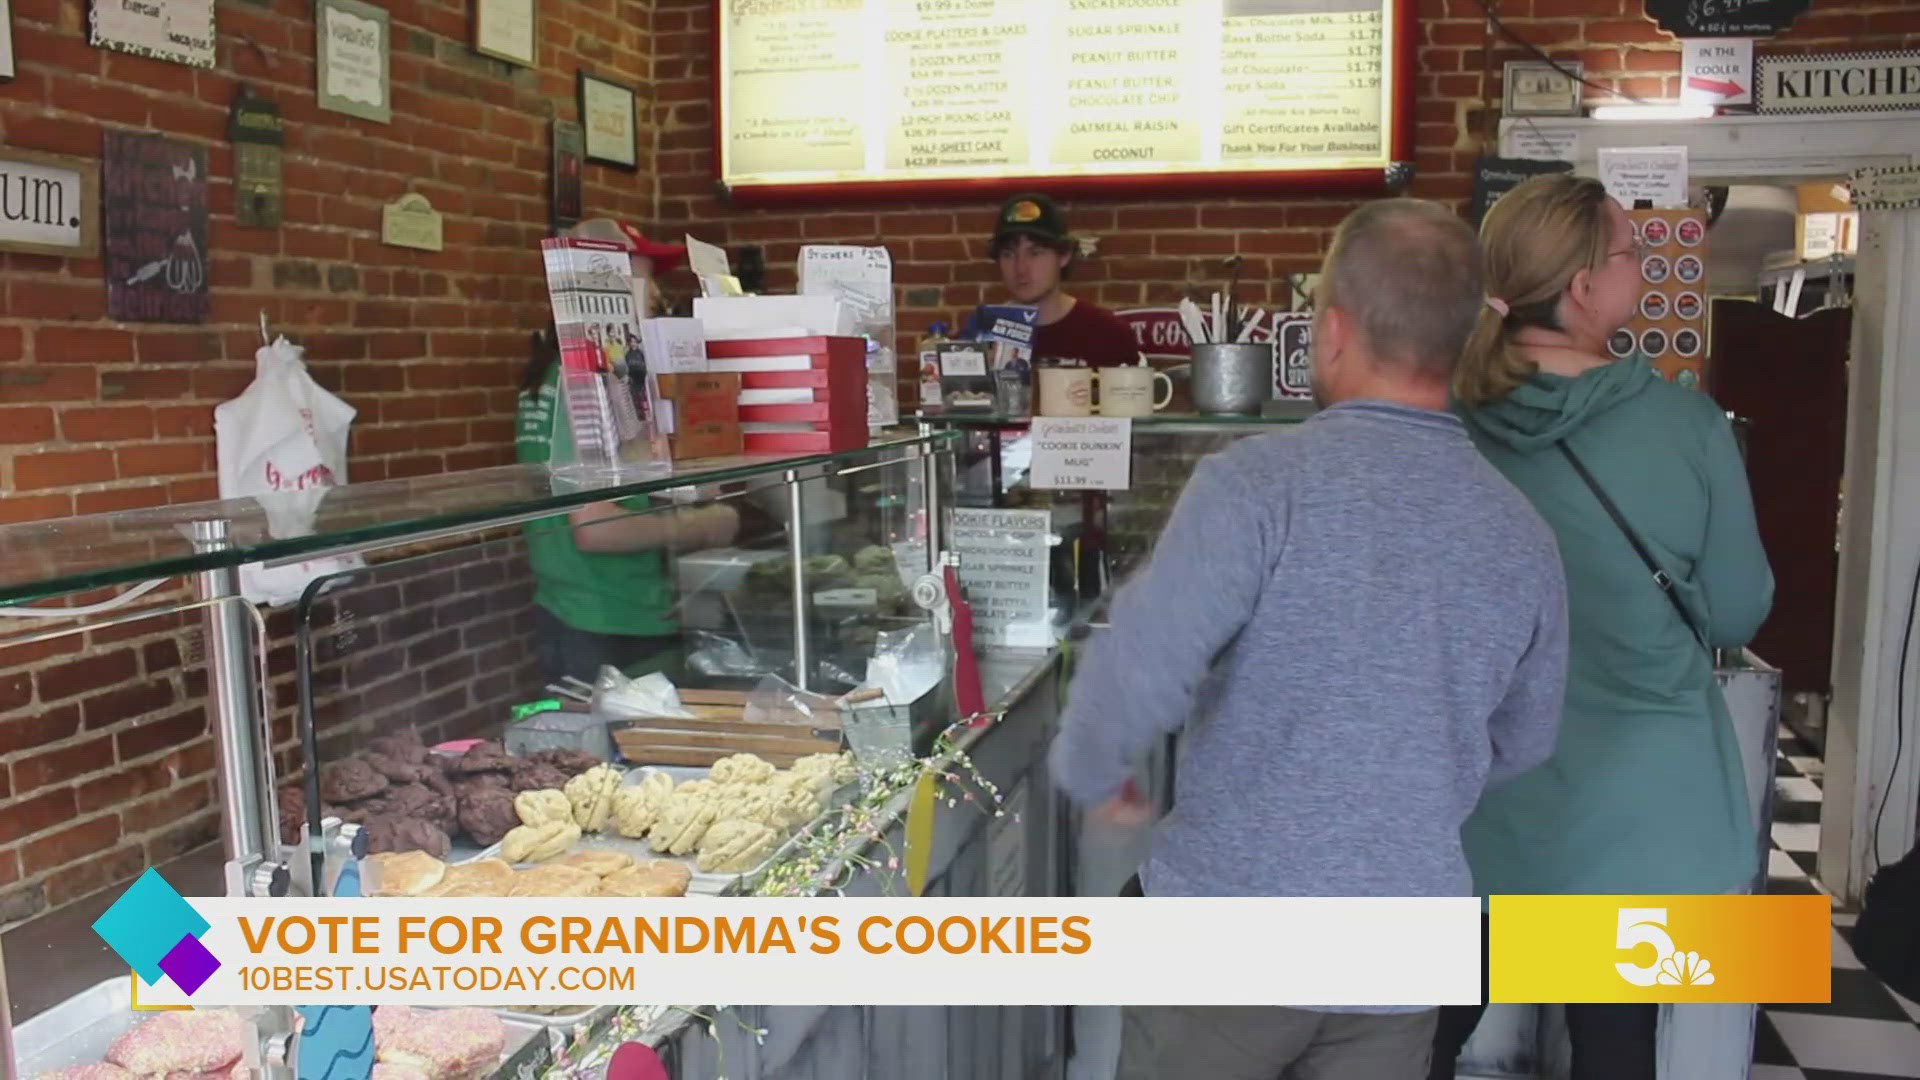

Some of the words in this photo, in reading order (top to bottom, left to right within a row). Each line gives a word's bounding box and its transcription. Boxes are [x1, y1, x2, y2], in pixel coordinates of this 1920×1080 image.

[1068, 25, 1112, 37] SUGAR
[1118, 23, 1180, 35] SPRINKLE
[1295, 31, 1326, 42] Soda
[957, 52, 1002, 64] PLATTER
[1072, 51, 1122, 64] PEANUT
[1127, 49, 1177, 62] BUTTER
[1699, 48, 1712, 57] IN
[1716, 47, 1736, 57] THE
[1695, 64, 1740, 75] COOLER
[964, 81, 1008, 93] PLATTER
[1068, 78, 1118, 90] PEANUT
[1123, 76, 1173, 88] BUTTER
[1069, 93, 1145, 107] CHOCOLATE
[1149, 92, 1180, 104] CHIP
[1070, 121, 1129, 135] OATMEAL
[1133, 119, 1178, 132] RAISIN
[1223, 123, 1245, 134] Gift
[1248, 122, 1320, 134] Certificates
[1322, 121, 1379, 133] Available
[940, 141, 973, 153] SHEET
[975, 140, 1002, 152] CAKE
[1092, 146, 1154, 160] COCONUT
[807, 248, 854, 260] STICKERS
[954, 514, 990, 527] OOKIE
[992, 515, 1045, 529] FLAVORS
